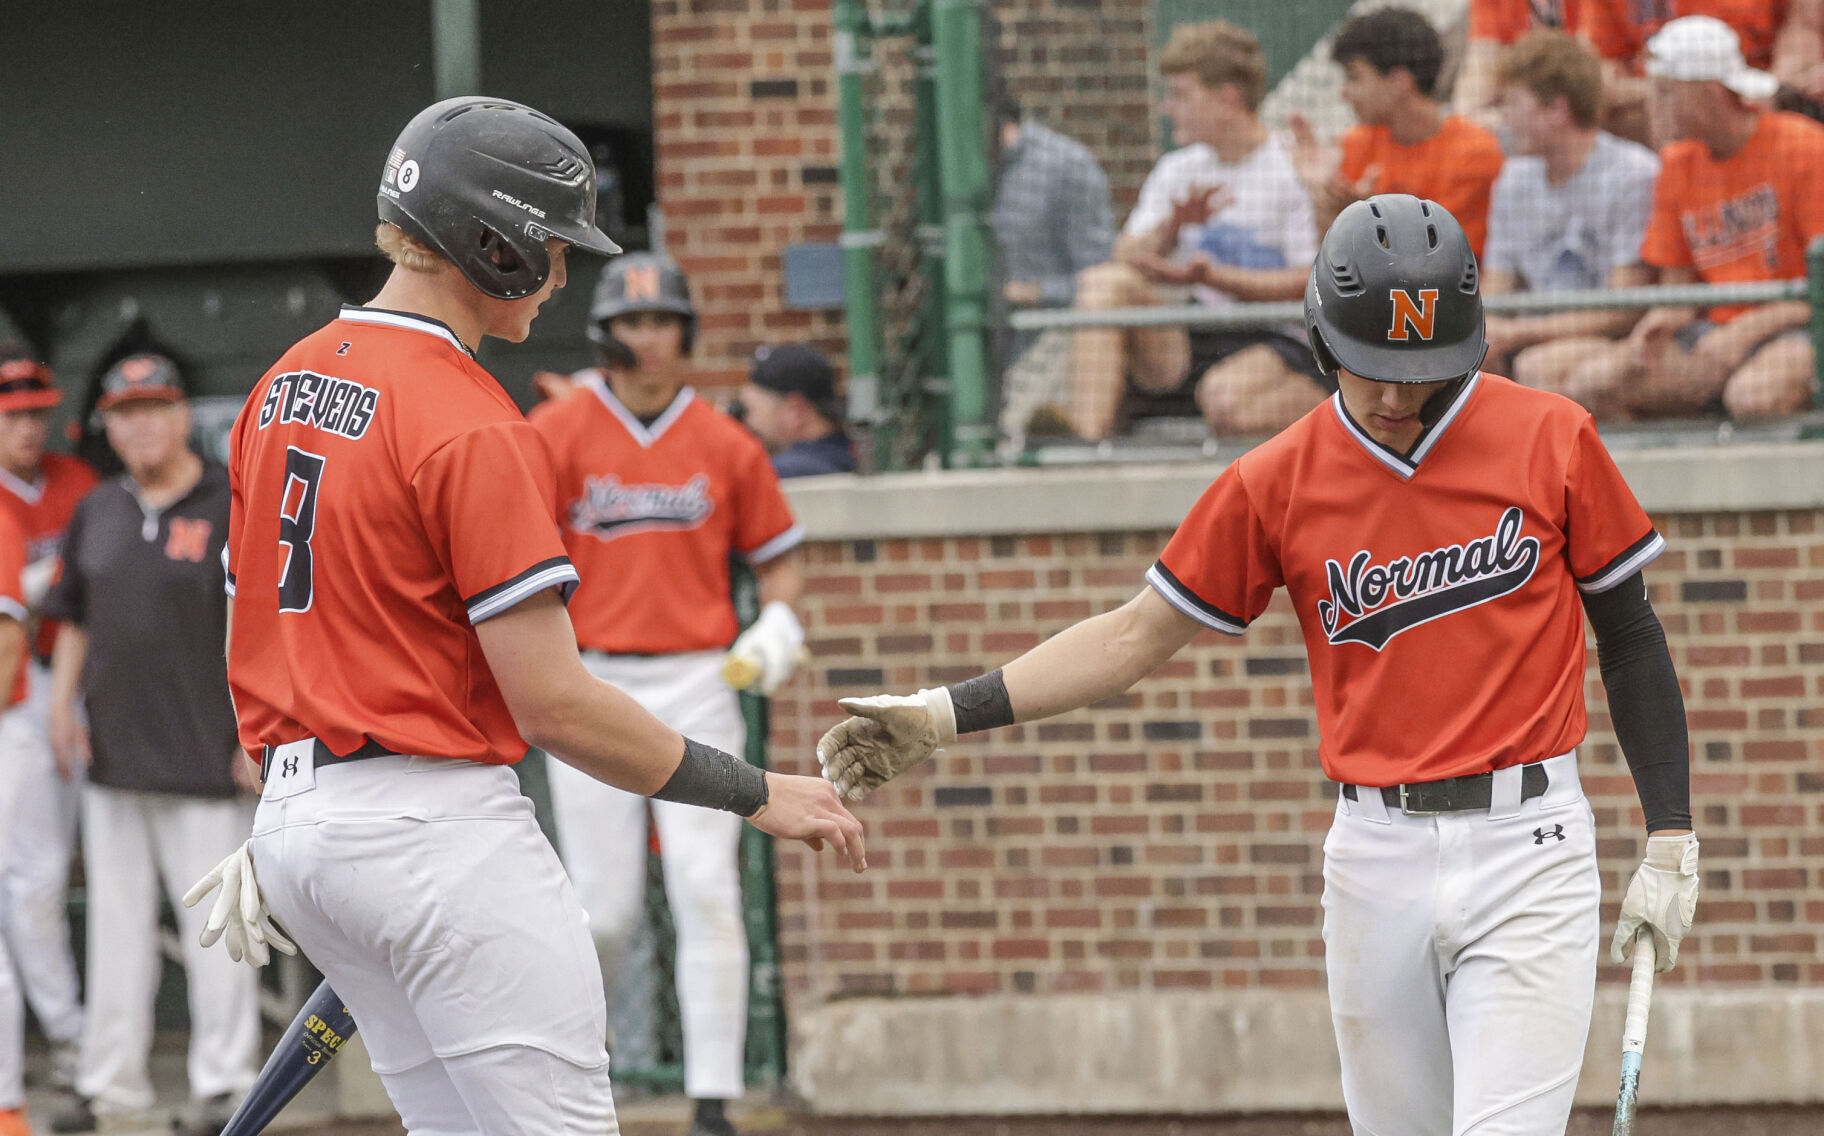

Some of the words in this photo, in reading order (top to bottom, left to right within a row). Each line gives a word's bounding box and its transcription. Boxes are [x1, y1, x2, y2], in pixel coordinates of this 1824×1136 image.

[492, 190, 547, 219] RAWLINGS
[1388, 289, 1439, 340] N
[336, 342, 352, 356] Z
[259, 370, 381, 440] STEVENS
[1318, 506, 1540, 640] Normal
[307, 1050, 321, 1065] 3
